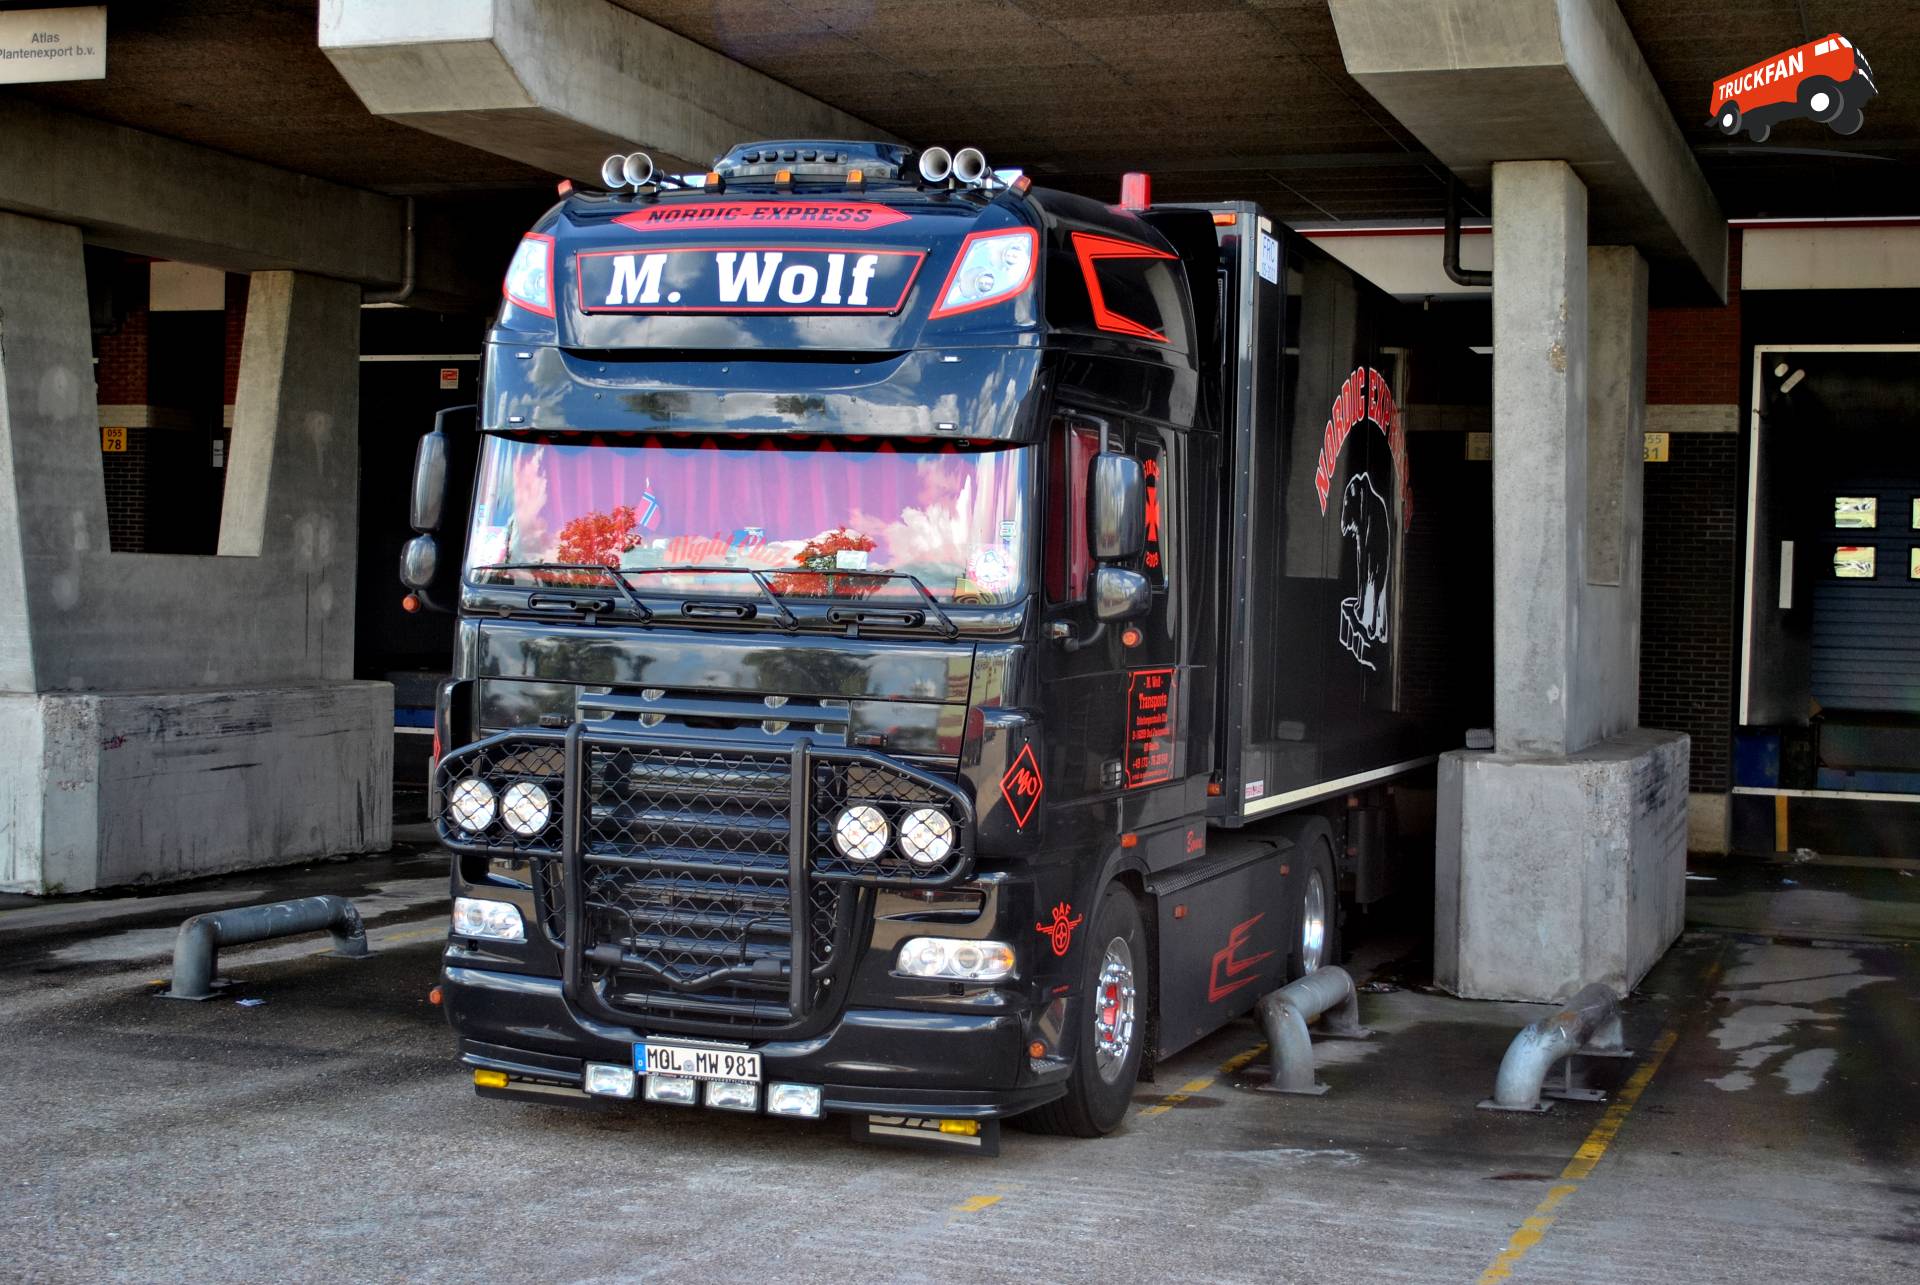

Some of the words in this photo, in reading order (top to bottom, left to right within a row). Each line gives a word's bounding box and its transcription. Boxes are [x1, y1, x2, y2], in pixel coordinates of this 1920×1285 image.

[31, 33, 60, 43] Atlas
[76, 45, 96, 56] b.v.
[646, 206, 873, 225] NORDIC-EXPRESS
[604, 253, 682, 306] M.
[715, 251, 879, 306] Wolf
[107, 439, 122, 450] 78
[1315, 366, 1365, 517] NORDIC
[1643, 434, 1662, 445] 55
[1052, 901, 1072, 920] DAF
[646, 1048, 682, 1071] MOL
[696, 1052, 719, 1074] MW
[724, 1055, 758, 1078] 981
